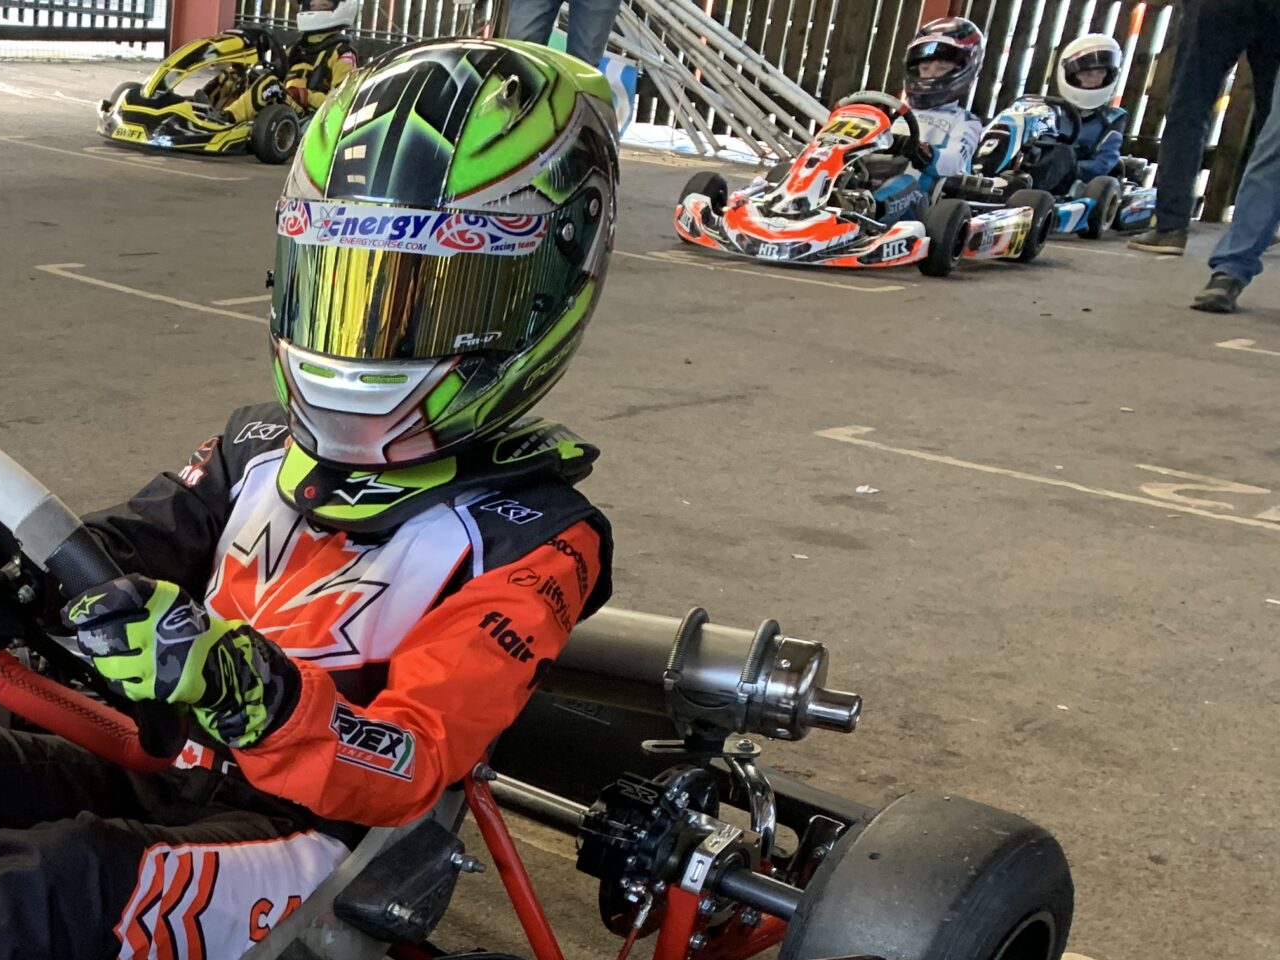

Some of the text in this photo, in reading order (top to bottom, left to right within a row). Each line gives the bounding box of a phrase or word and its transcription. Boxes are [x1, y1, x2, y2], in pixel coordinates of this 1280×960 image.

[115, 128, 143, 139] SWIFT
[883, 240, 908, 258] HTR
[478, 611, 535, 662] flair
